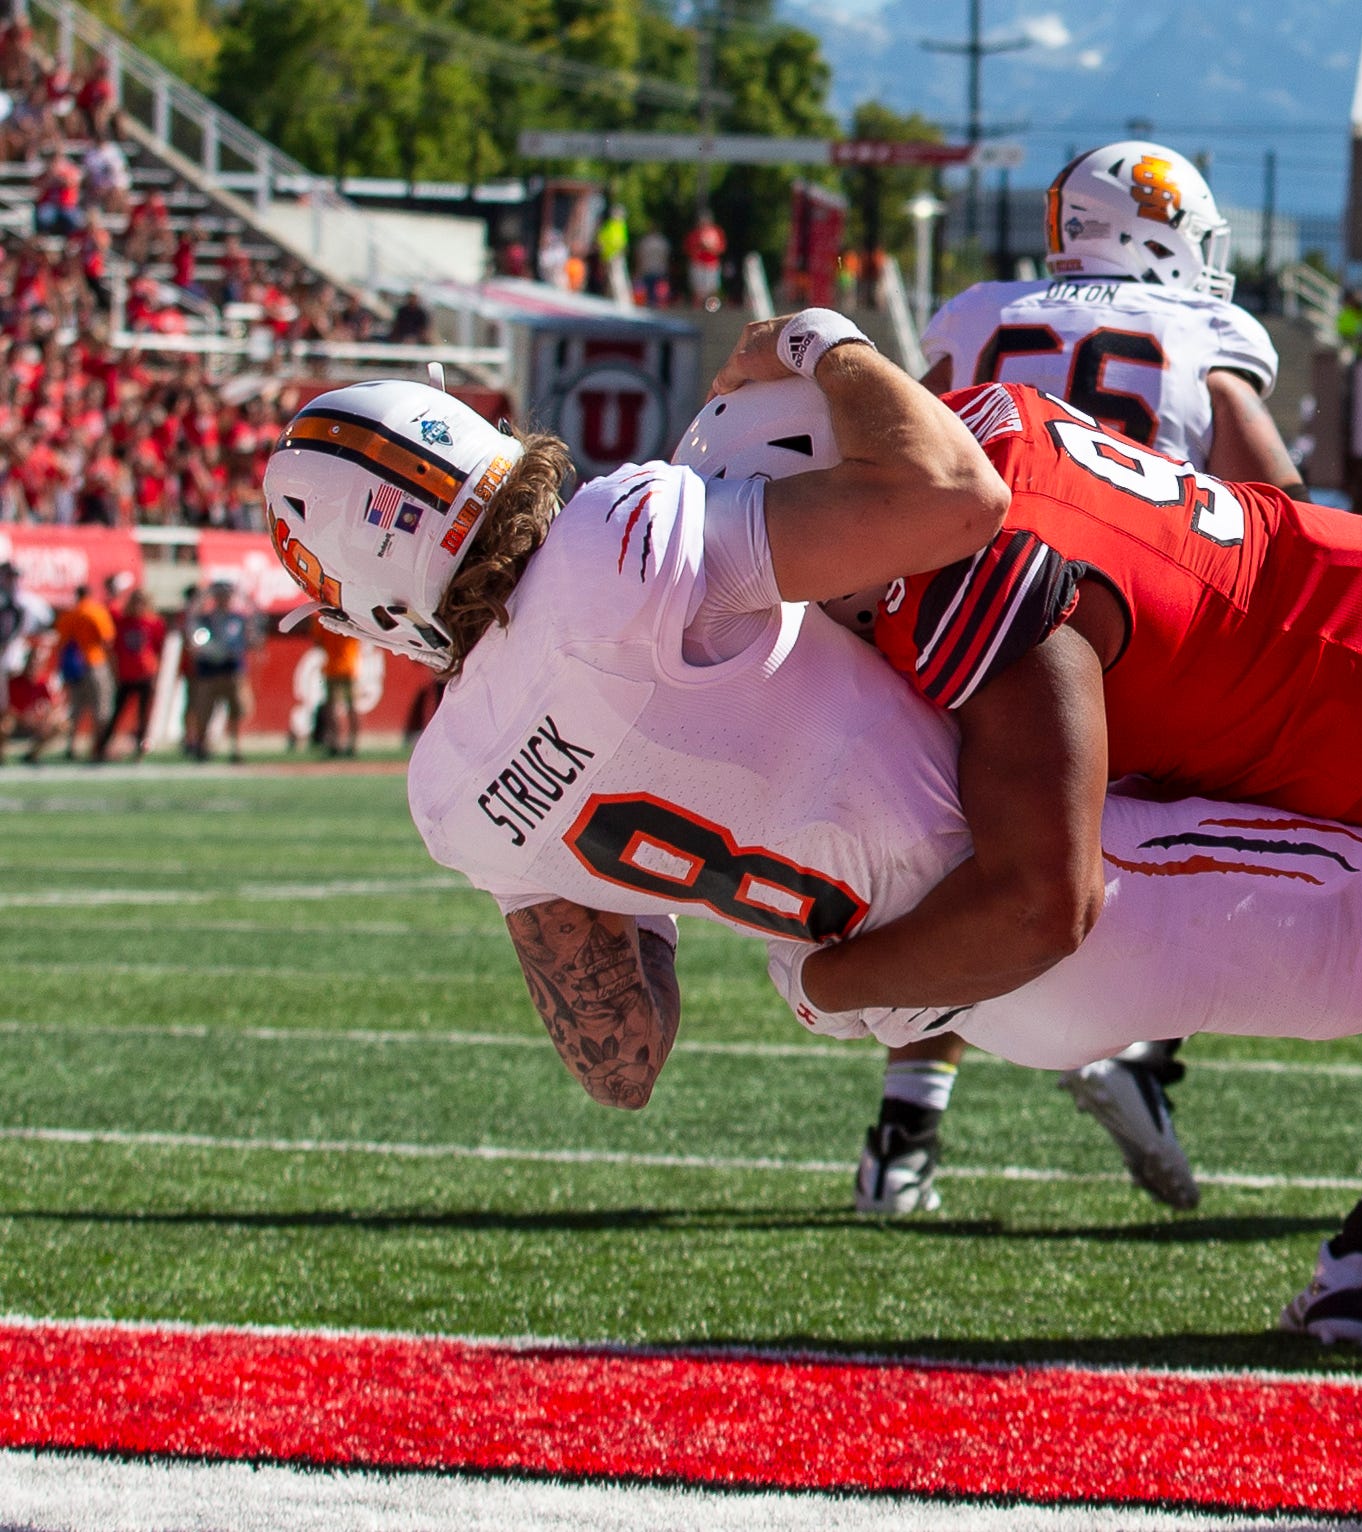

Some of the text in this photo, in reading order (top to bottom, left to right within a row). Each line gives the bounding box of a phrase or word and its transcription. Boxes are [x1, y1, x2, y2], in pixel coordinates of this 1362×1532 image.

[1046, 282, 1120, 304] DIXON
[795, 333, 815, 368] adidas
[477, 714, 595, 848] STRUCK
[561, 790, 871, 944] 8
